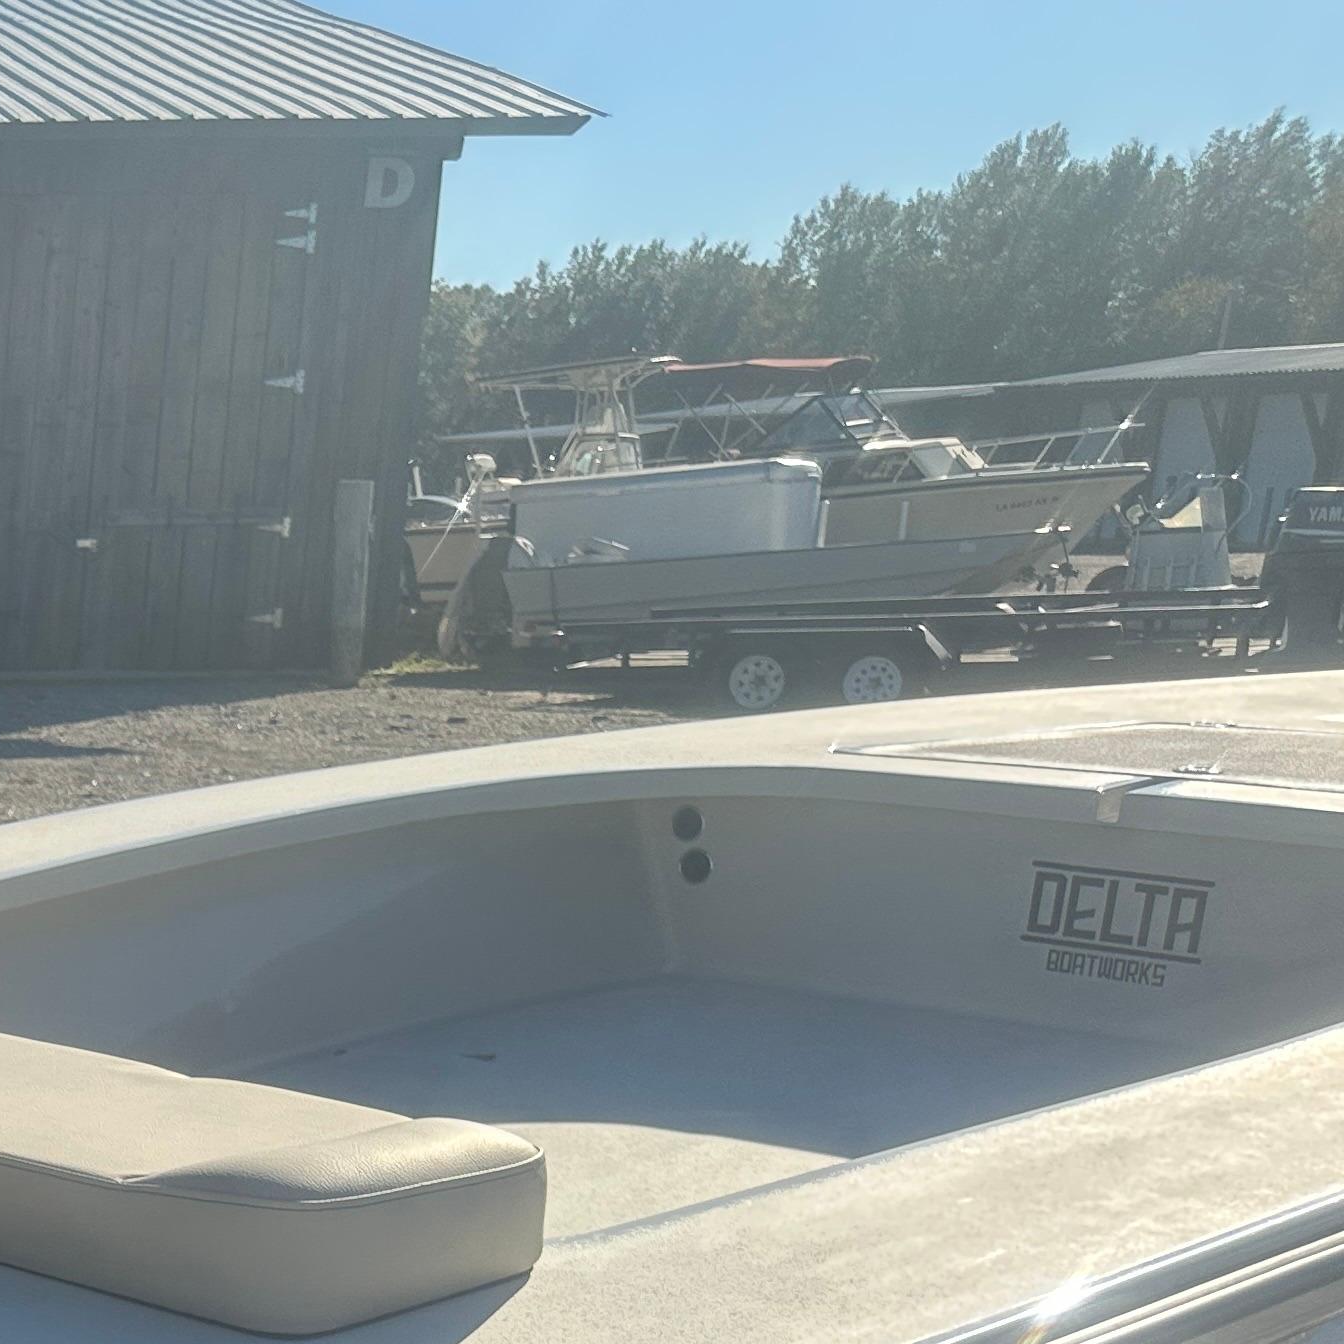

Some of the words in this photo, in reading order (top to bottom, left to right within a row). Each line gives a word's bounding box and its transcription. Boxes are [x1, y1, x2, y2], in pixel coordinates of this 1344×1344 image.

[364, 157, 415, 208] D
[1309, 506, 1344, 522] YAM
[1026, 871, 1209, 954] DELTA
[1046, 949, 1167, 987] BOATWORKS
